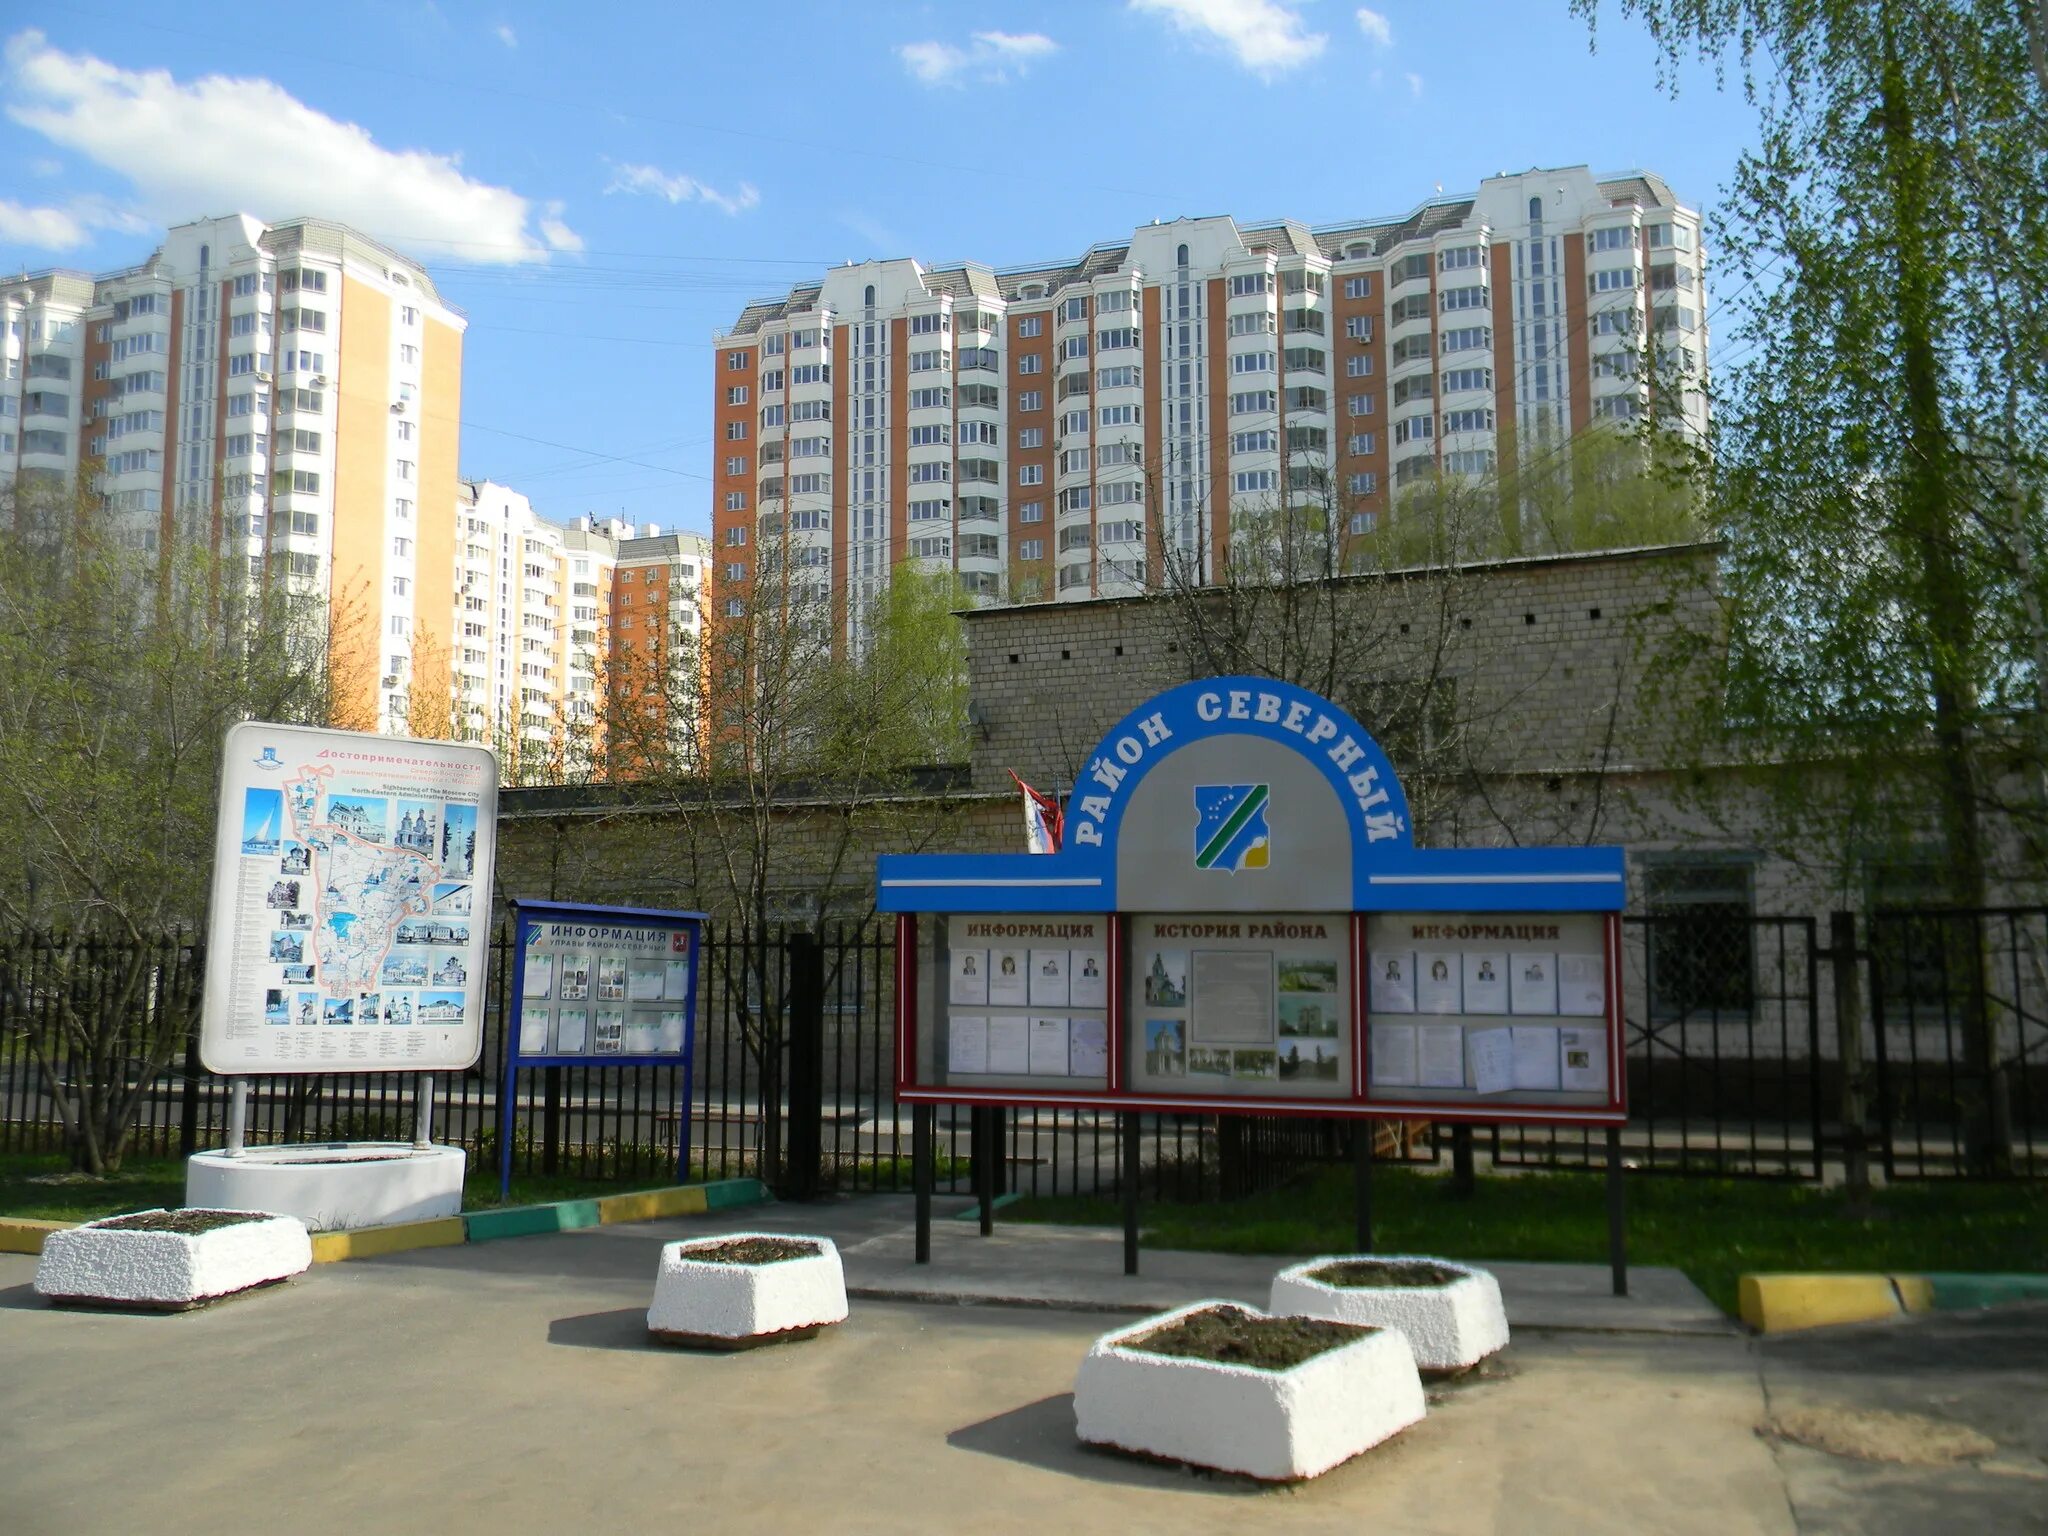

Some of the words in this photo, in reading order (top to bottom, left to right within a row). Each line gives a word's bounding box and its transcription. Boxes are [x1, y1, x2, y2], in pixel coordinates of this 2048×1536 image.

[316, 749, 481, 771] Достопримечательности
[1075, 711, 1173, 848] РАЙОН
[1197, 691, 1405, 844] СЕВЕРНЫЙ
[351, 787, 399, 797] North-Eastern
[399, 791, 444, 801] Administrative
[445, 795, 479, 804] Community
[382, 783, 421, 794] Sightseeing
[442, 788, 466, 796] Moscow
[551, 925, 666, 942] ИНФОРМАЦИЯ
[967, 923, 1094, 939] ИНФОРМАЦИЯ
[1154, 923, 1240, 938] ИСТОРИЯ
[1248, 922, 1328, 939] РАЙОНА
[1412, 925, 1560, 941] ИНФОРМАЦИЯ
[550, 939, 584, 948] УПРАВЫ
[586, 941, 619, 949] РАЙОНА
[621, 943, 666, 952] СЕВЕРНЫЙ
